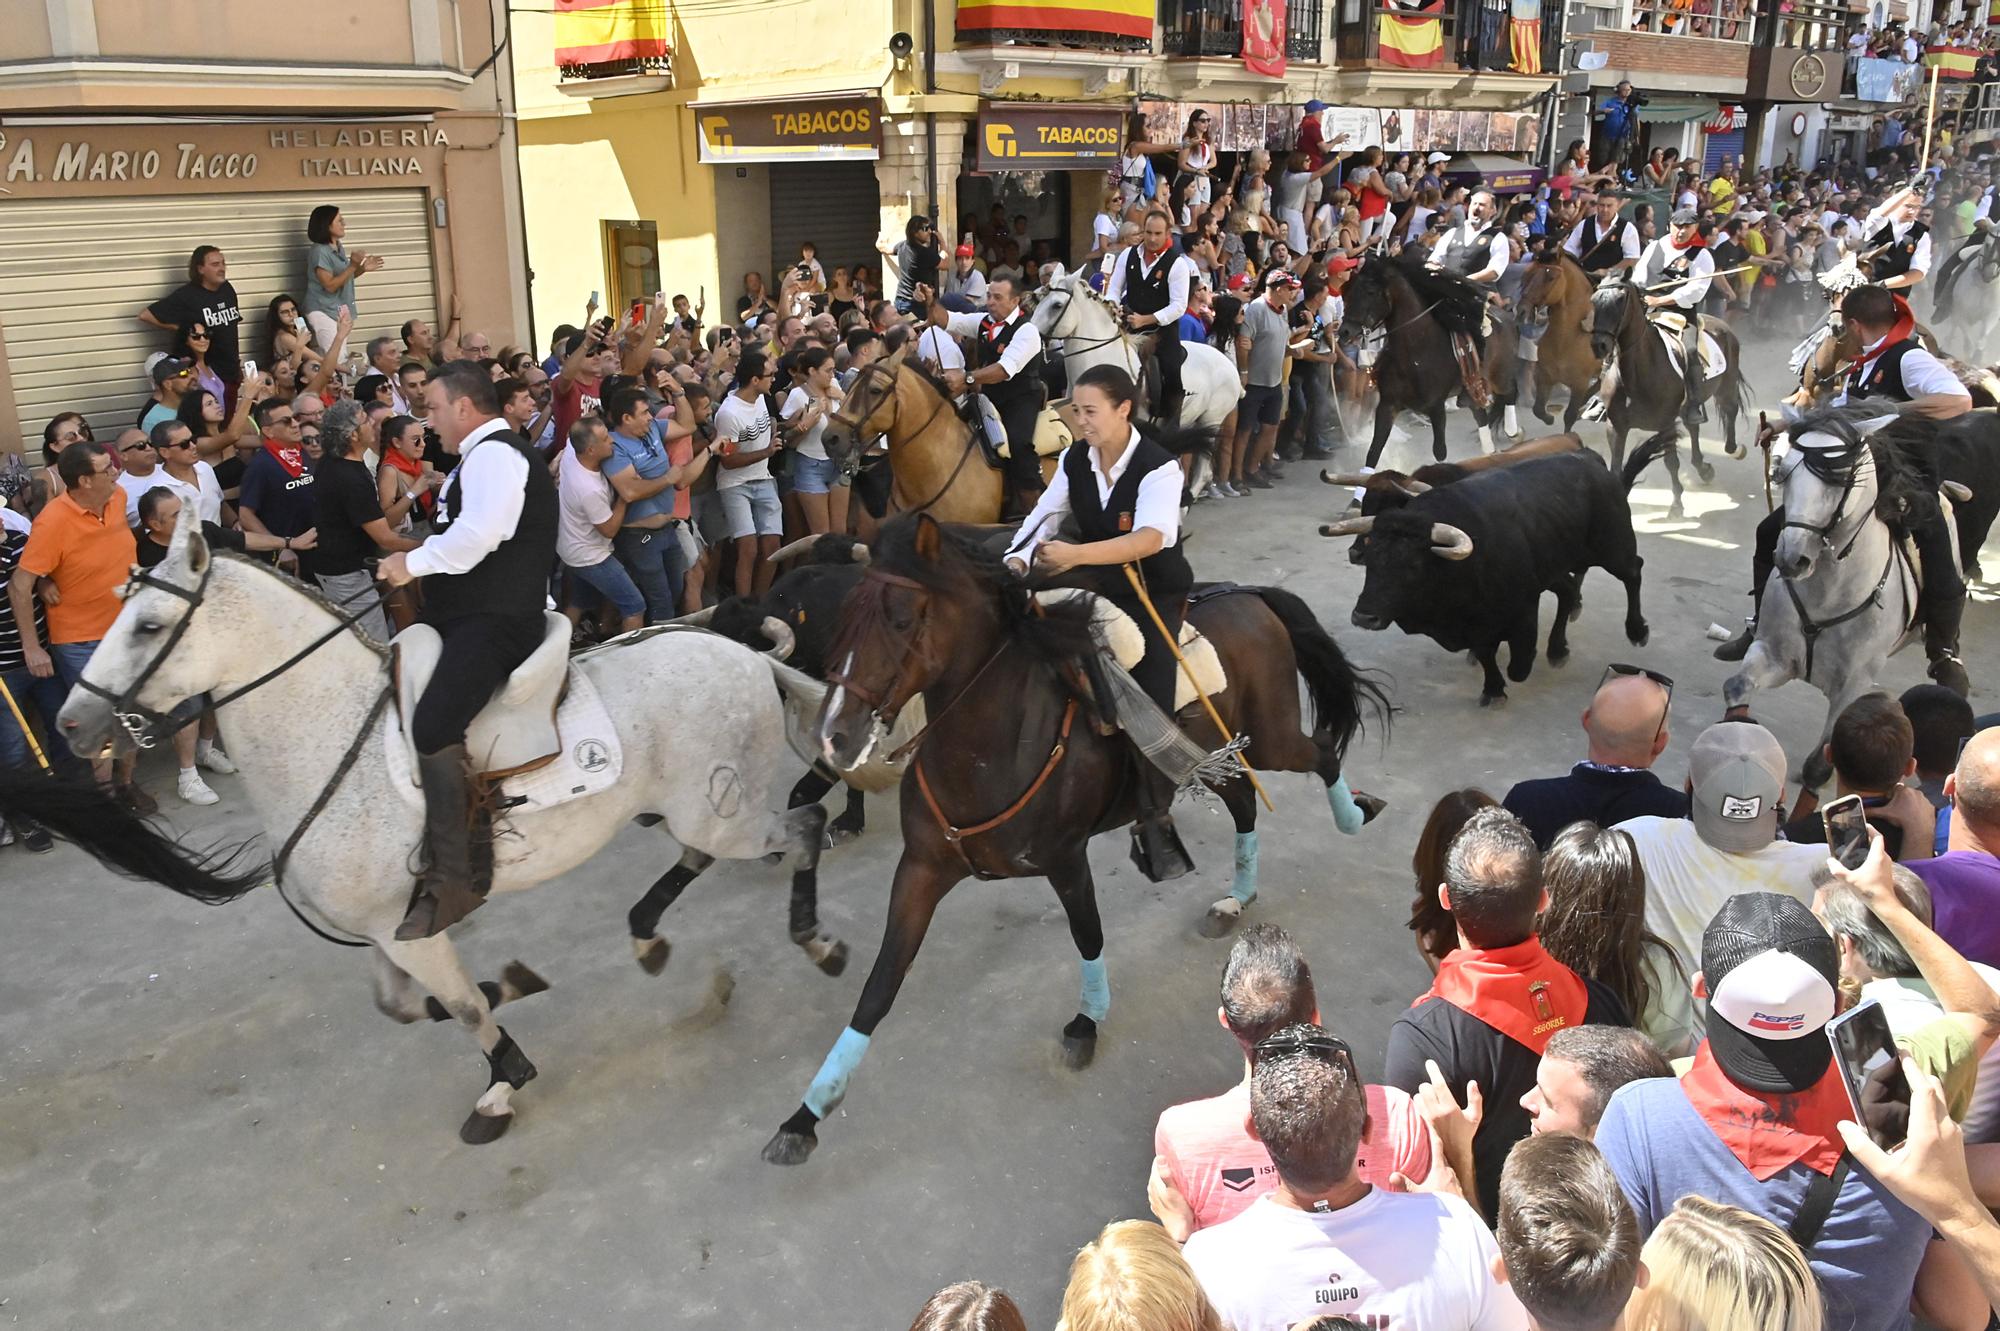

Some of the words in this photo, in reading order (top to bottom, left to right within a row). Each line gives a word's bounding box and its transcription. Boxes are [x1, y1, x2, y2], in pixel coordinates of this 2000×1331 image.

[771, 108, 872, 136] TABACOS
[269, 128, 450, 149] HELADERIA
[1037, 126, 1118, 144] TABACOS
[6, 138, 43, 182] A.
[52, 142, 160, 182] MARIO
[176, 143, 258, 180] TACCO
[301, 156, 423, 177] ITALIANA
[202, 306, 240, 327] BEATLES
[1532, 1016, 1566, 1036] SEGORBE
[1753, 1011, 1805, 1023] PEPSI
[1315, 1287, 1359, 1304] EQUIPO
